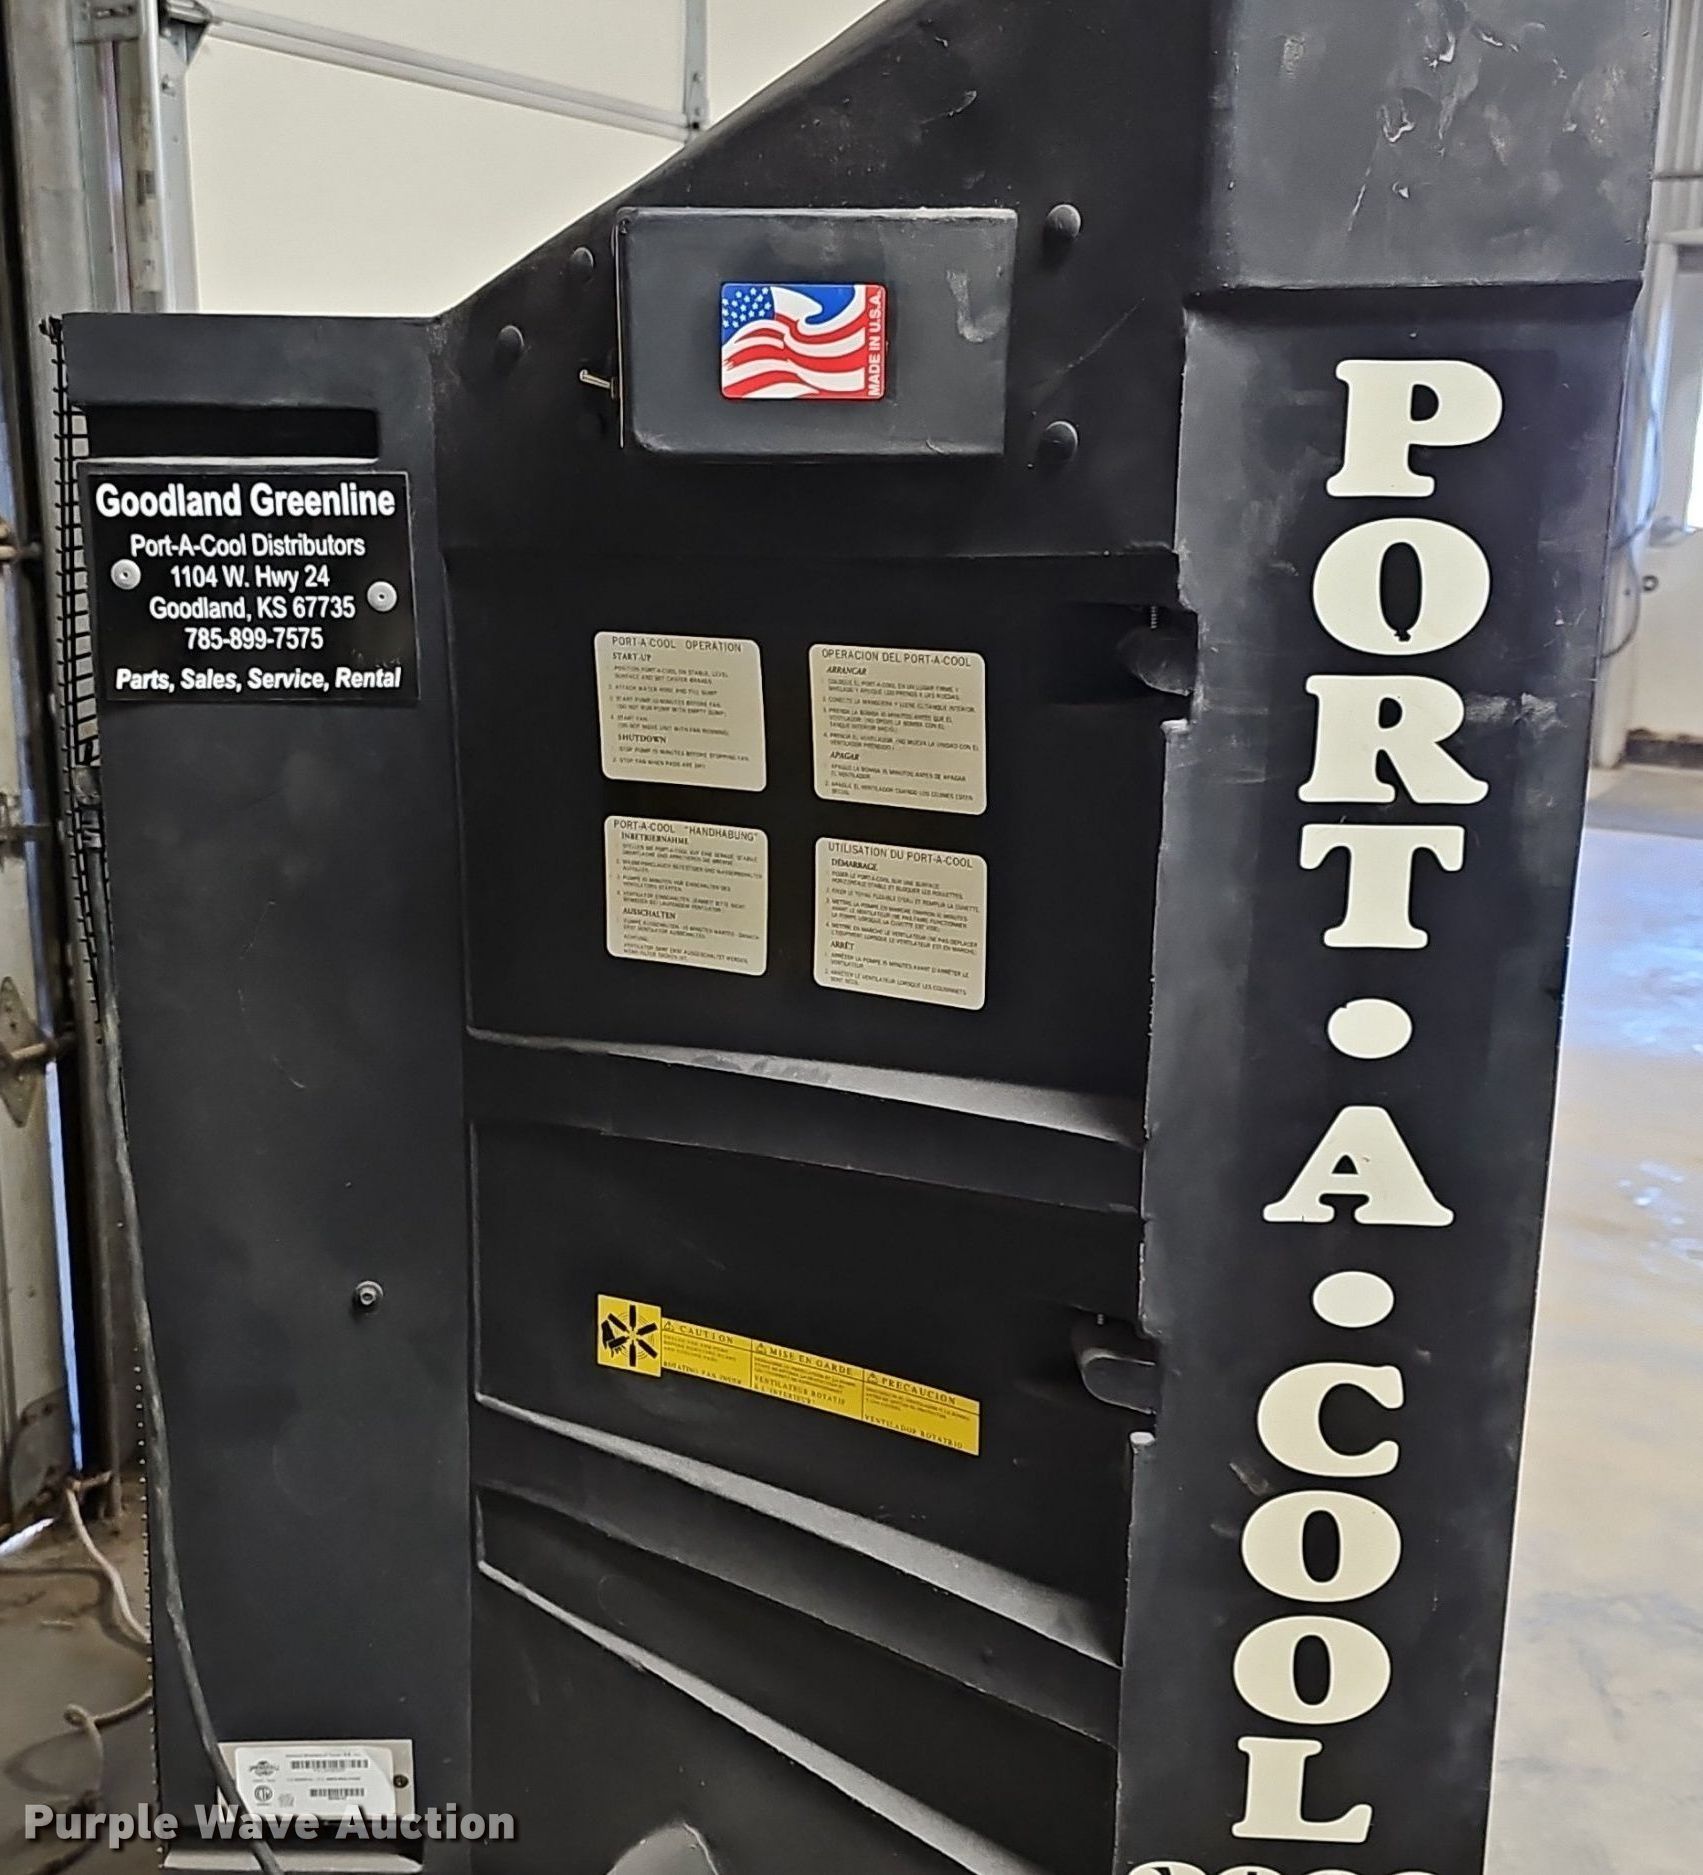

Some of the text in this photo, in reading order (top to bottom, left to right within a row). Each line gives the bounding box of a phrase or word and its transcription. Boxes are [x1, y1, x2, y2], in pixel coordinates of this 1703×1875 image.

[868, 335, 881, 351] IN
[868, 353, 881, 396] MADE
[96, 483, 396, 517] Goodland Greenline
[130, 533, 366, 557] Port-A-Cool Distributors
[171, 565, 331, 594] 1104 W. Hwy 24
[150, 596, 356, 622] Goodland, KS 67735
[185, 627, 324, 650] 785-899-7575
[685, 640, 742, 653] OPERATION
[882, 652, 902, 663] DEL
[903, 653, 972, 667] PORT-A-COOL
[116, 667, 402, 693] Parts, Sales, Service, Rental
[618, 734, 666, 744] SHUTDOWN
[830, 751, 859, 761] APAGAR
[613, 819, 675, 834] PORT-A-COOL
[621, 831, 689, 845] INBETRIEBNAHME
[828, 841, 973, 869] UTILISATION DU PORT-A-COOL
[623, 907, 676, 919] AUSSCHALTEN
[680, 1325, 733, 1344] CAUTION
[769, 1346, 795, 1360] MISE
[798, 1355, 812, 1365] EN
[816, 1359, 851, 1375] GARDE
[881, 1377, 956, 1405] PRECAUCION
